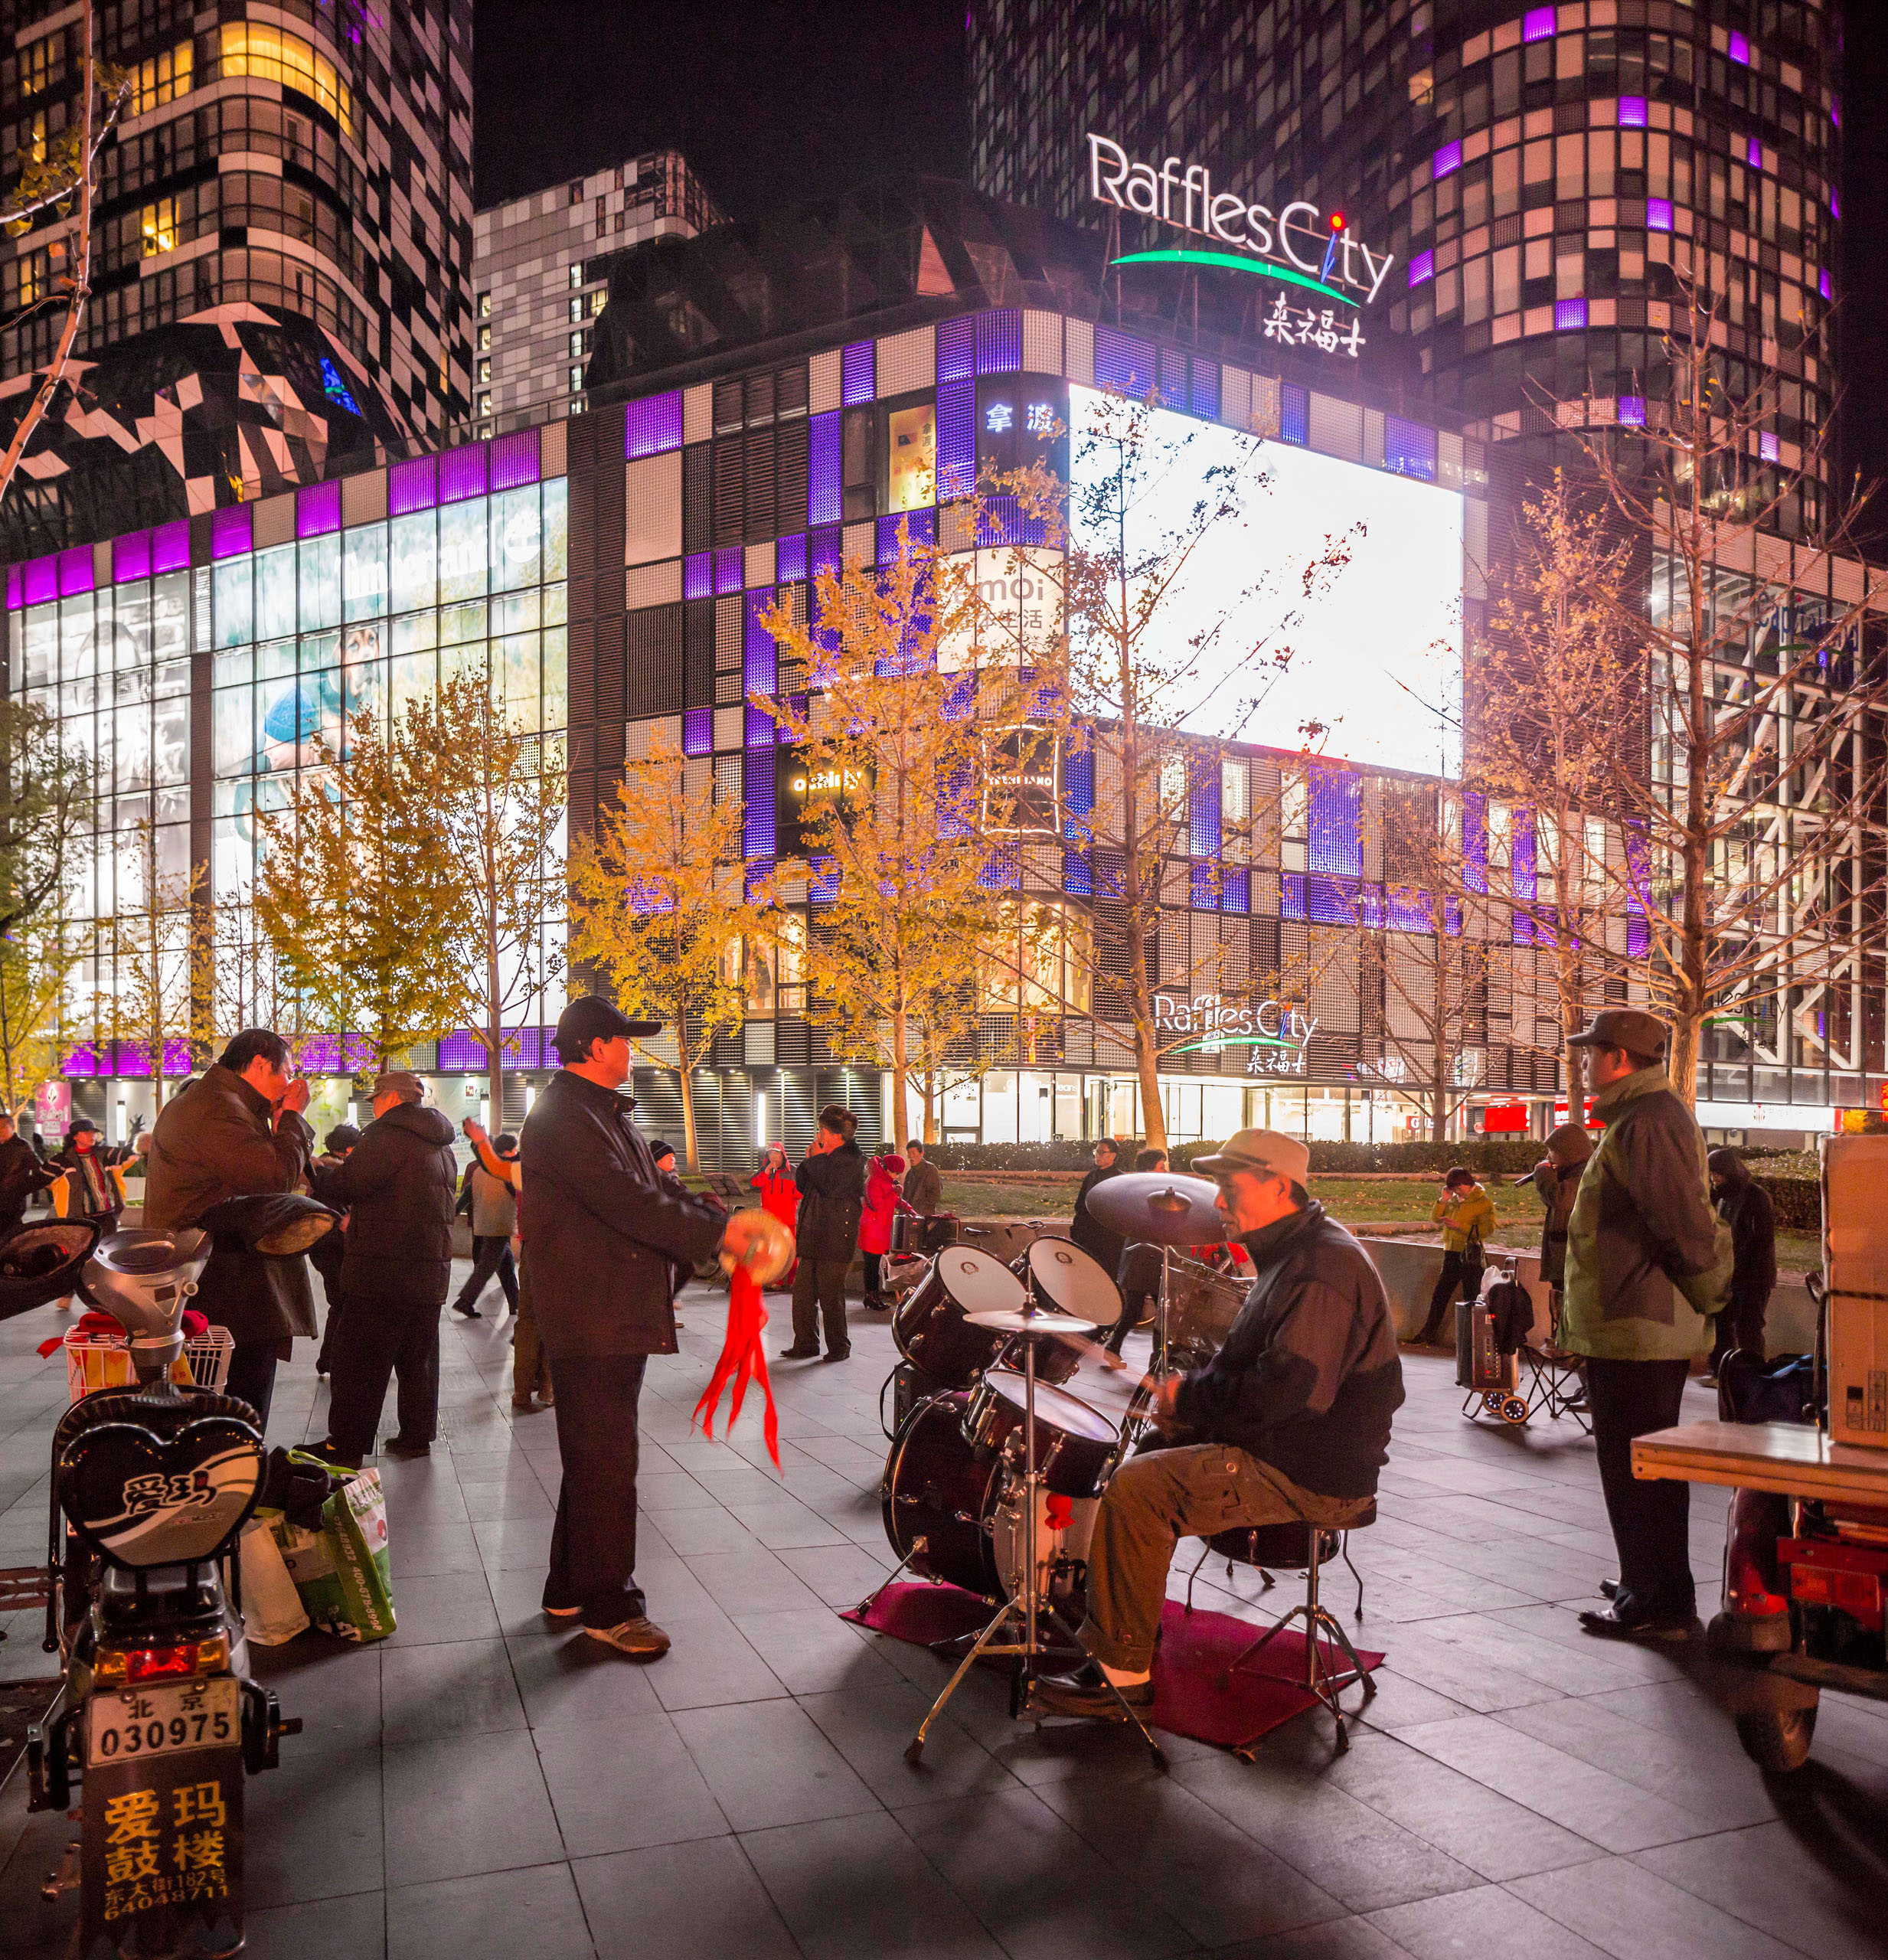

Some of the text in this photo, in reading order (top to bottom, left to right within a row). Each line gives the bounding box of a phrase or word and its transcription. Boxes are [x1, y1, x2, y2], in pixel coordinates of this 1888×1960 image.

[1263, 291, 1366, 358] 来福士
[1246, 1045, 1306, 1074] 来福士
[128, 1693, 204, 1720] 北京
[101, 1712, 230, 1757] 030975
[104, 1780, 226, 1845] 爱玛
[104, 1830, 225, 1886] 鼓楼
[104, 1885, 229, 1921] 64048711
